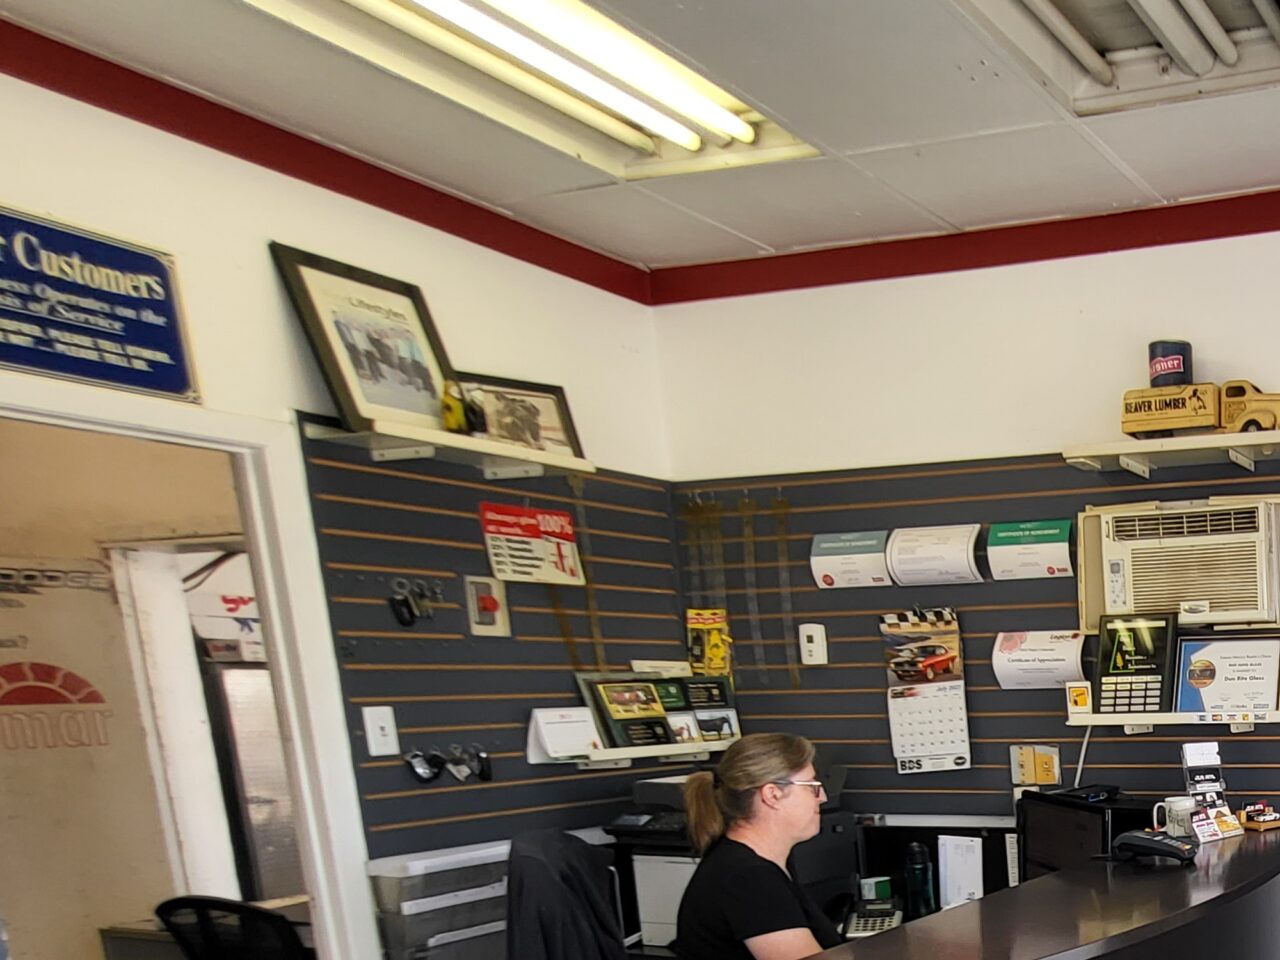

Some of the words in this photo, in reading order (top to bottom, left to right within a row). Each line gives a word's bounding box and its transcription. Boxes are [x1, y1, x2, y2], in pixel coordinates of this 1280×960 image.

[13, 231, 166, 300] Customers
[1125, 401, 1153, 414] BEAVER
[1154, 397, 1187, 411] LUMBER
